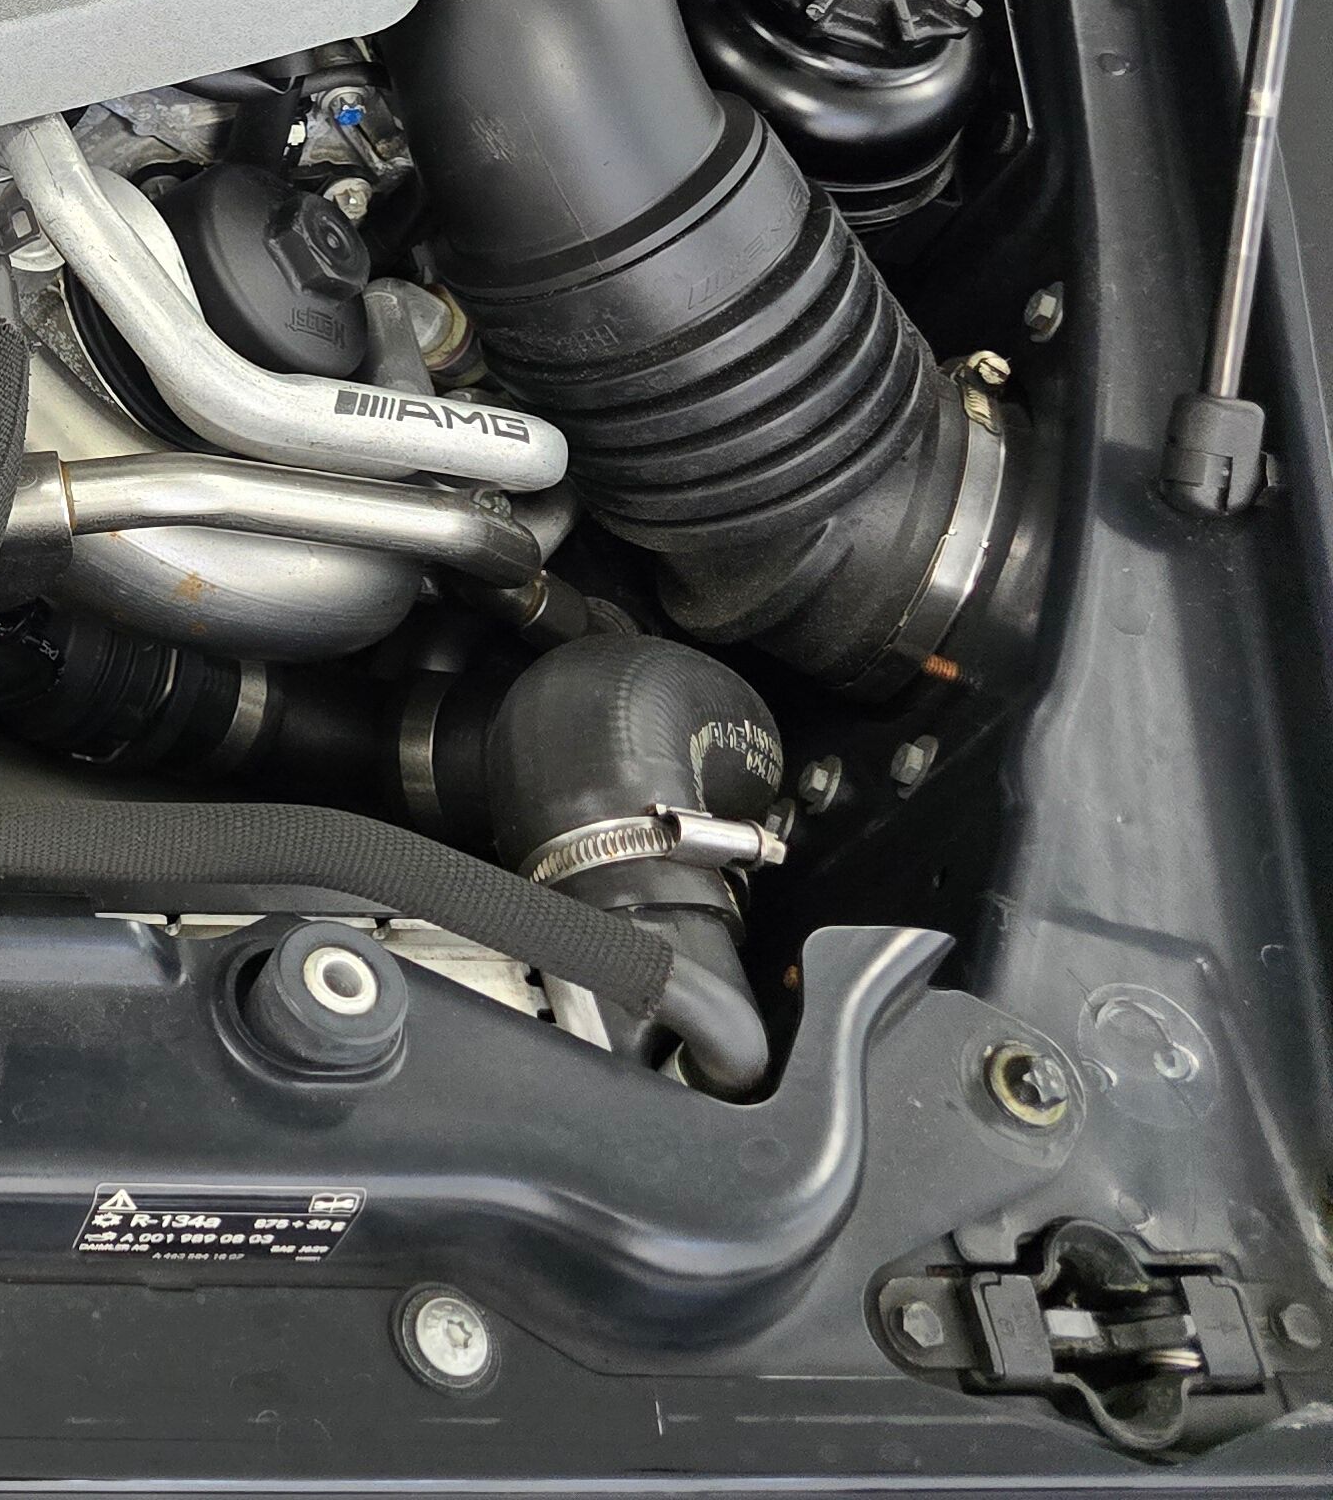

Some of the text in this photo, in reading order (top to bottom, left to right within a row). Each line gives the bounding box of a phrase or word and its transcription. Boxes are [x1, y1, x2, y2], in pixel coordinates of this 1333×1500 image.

[396, 399, 531, 444] AMG
[130, 1214, 222, 1229] R-134a
[120, 1233, 135, 1243] A
[139, 1233, 175, 1243] 001
